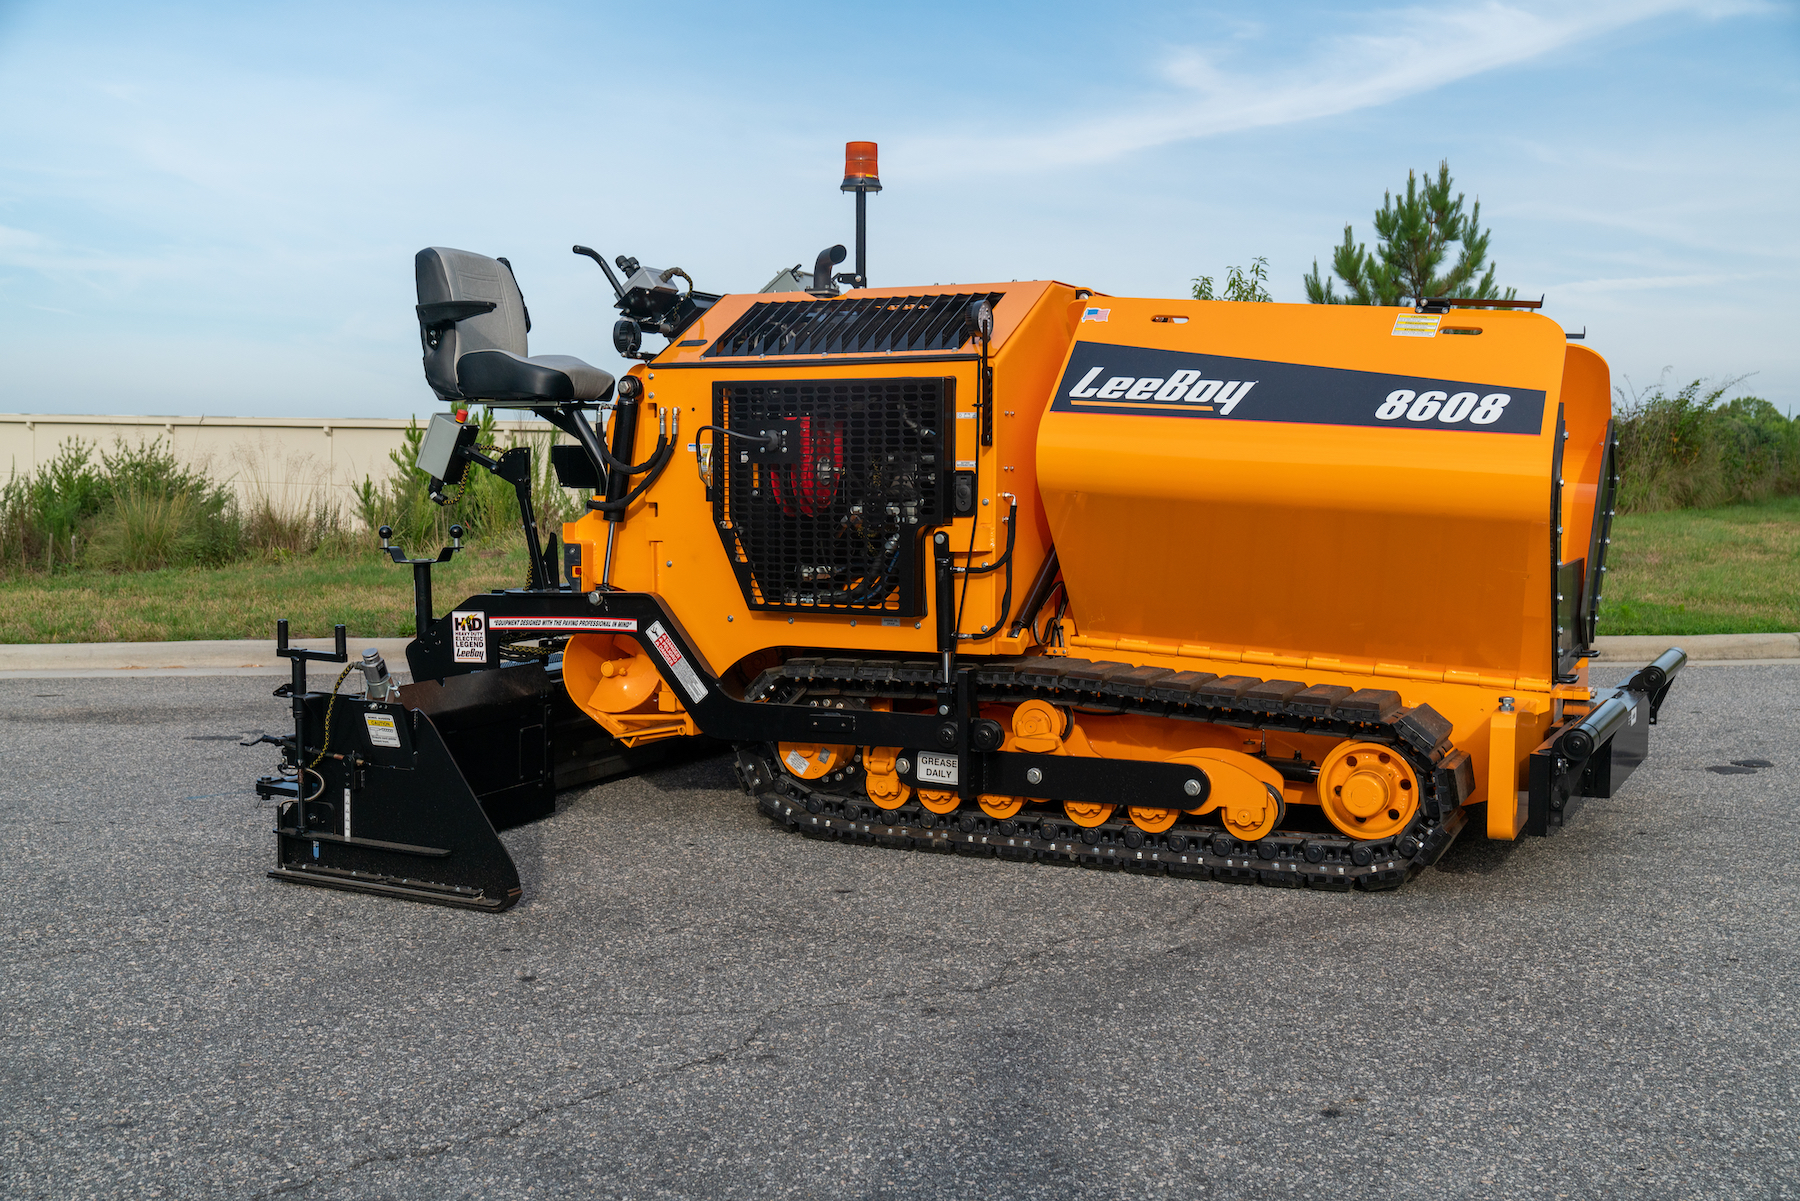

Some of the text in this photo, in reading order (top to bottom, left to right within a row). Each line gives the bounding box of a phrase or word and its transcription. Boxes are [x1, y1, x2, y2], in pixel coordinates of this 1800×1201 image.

[1068, 366, 1257, 416] LeeBoy
[1374, 388, 1511, 425] 8608
[456, 648, 485, 660] LeeBoy
[662, 641, 678, 663] PELIGRO
[665, 638, 681, 659] DANGER
[921, 756, 957, 768] GREASE
[926, 768, 953, 778] DAILY
